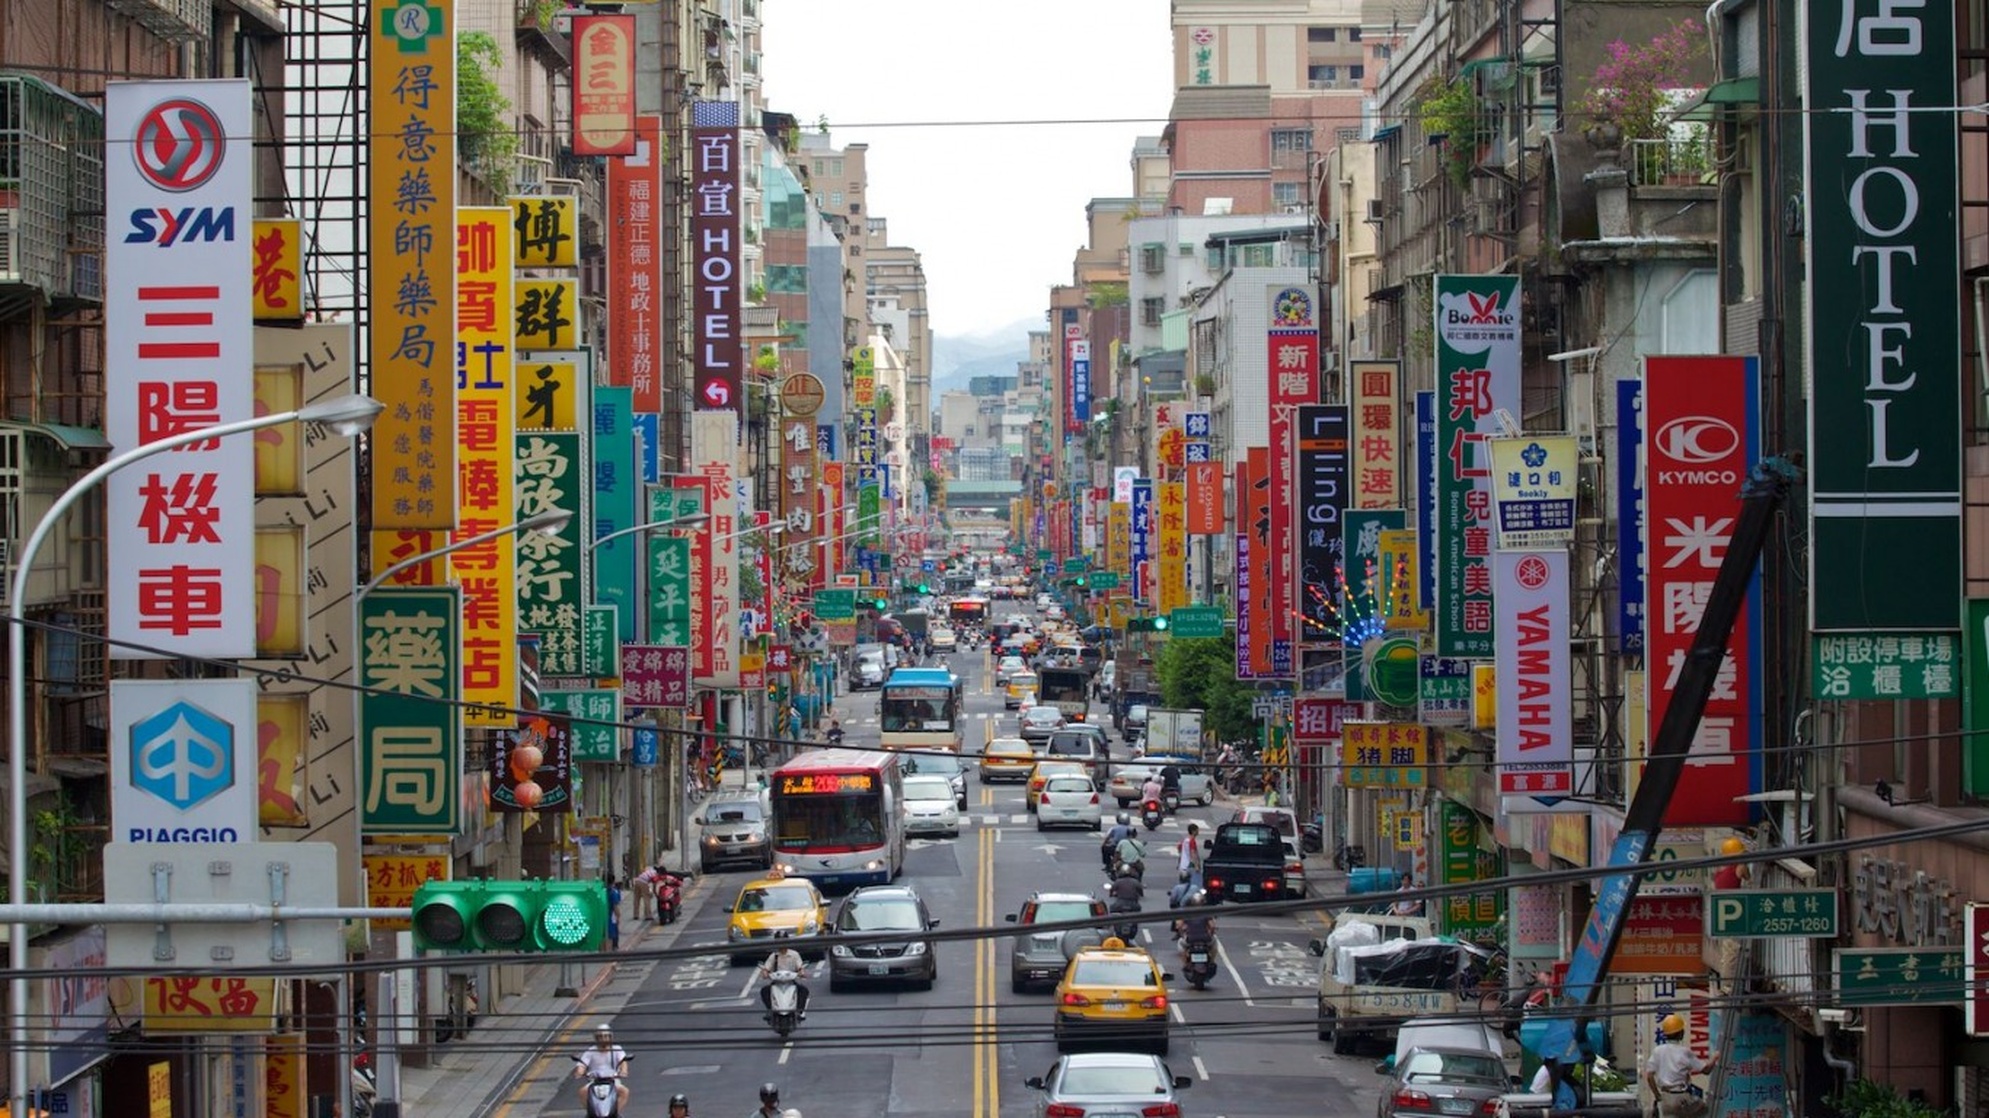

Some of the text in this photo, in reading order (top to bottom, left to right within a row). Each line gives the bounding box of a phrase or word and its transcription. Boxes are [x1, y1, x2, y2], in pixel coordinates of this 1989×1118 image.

[124, 206, 235, 248] SYM
[389, 65, 439, 369] 得意藥師藥局
[698, 134, 733, 216] 百宣
[630, 272, 653, 394] 地政士事務所
[702, 228, 733, 368] HOTEL
[1448, 309, 1515, 326] Bonnie
[1842, 89, 1920, 468] HOTEL
[137, 286, 222, 636] 三陽機車
[1658, 471, 1737, 485] KYMCO
[1451, 491, 1459, 632] Bonnie American School
[1517, 604, 1552, 751] YAMAHA
[1820, 637, 1953, 665] 附設停車場
[365, 610, 446, 816] 藥局
[1717, 899, 1743, 931] P
[1763, 917, 1830, 934] 2557-1260
